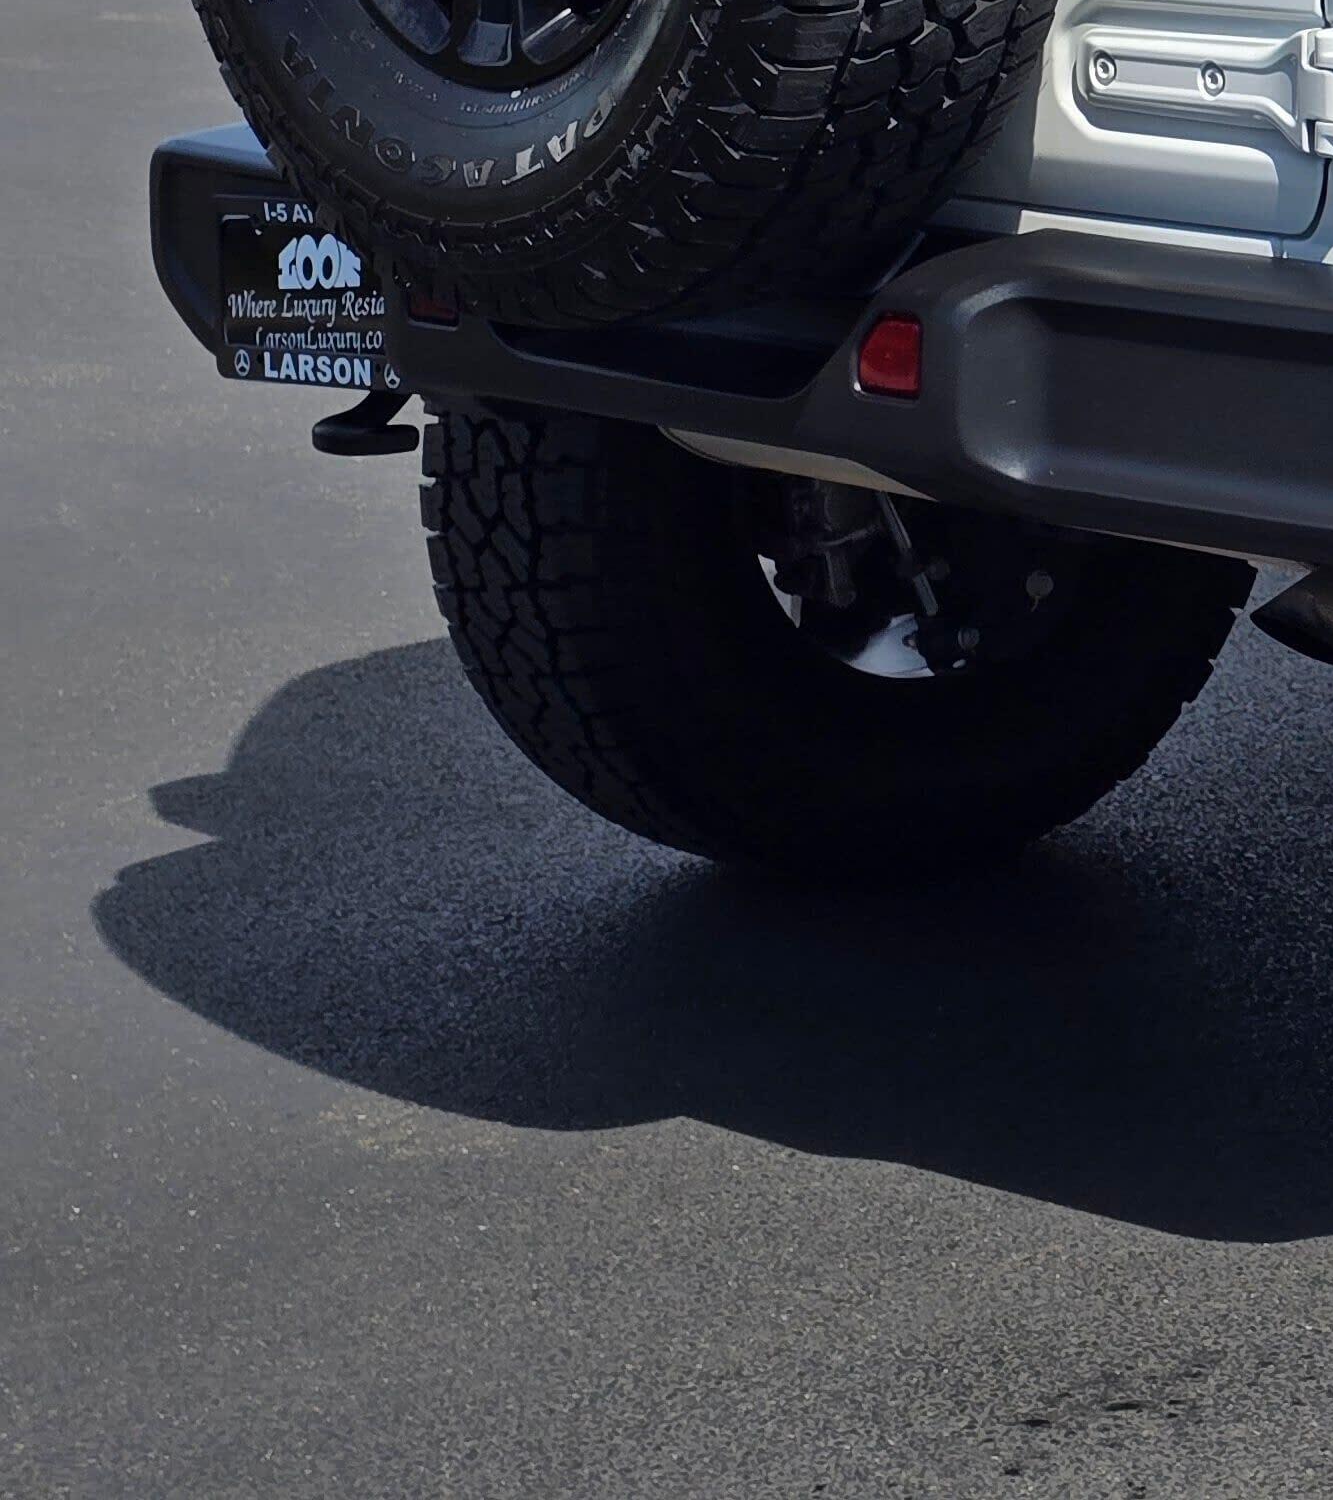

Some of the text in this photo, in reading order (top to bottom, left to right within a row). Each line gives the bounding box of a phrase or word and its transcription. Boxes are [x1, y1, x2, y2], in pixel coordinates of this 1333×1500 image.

[263, 202, 288, 223] I-5
[227, 289, 277, 318] Where
[281, 292, 337, 328] Luxury
[263, 351, 372, 387] LARSON
